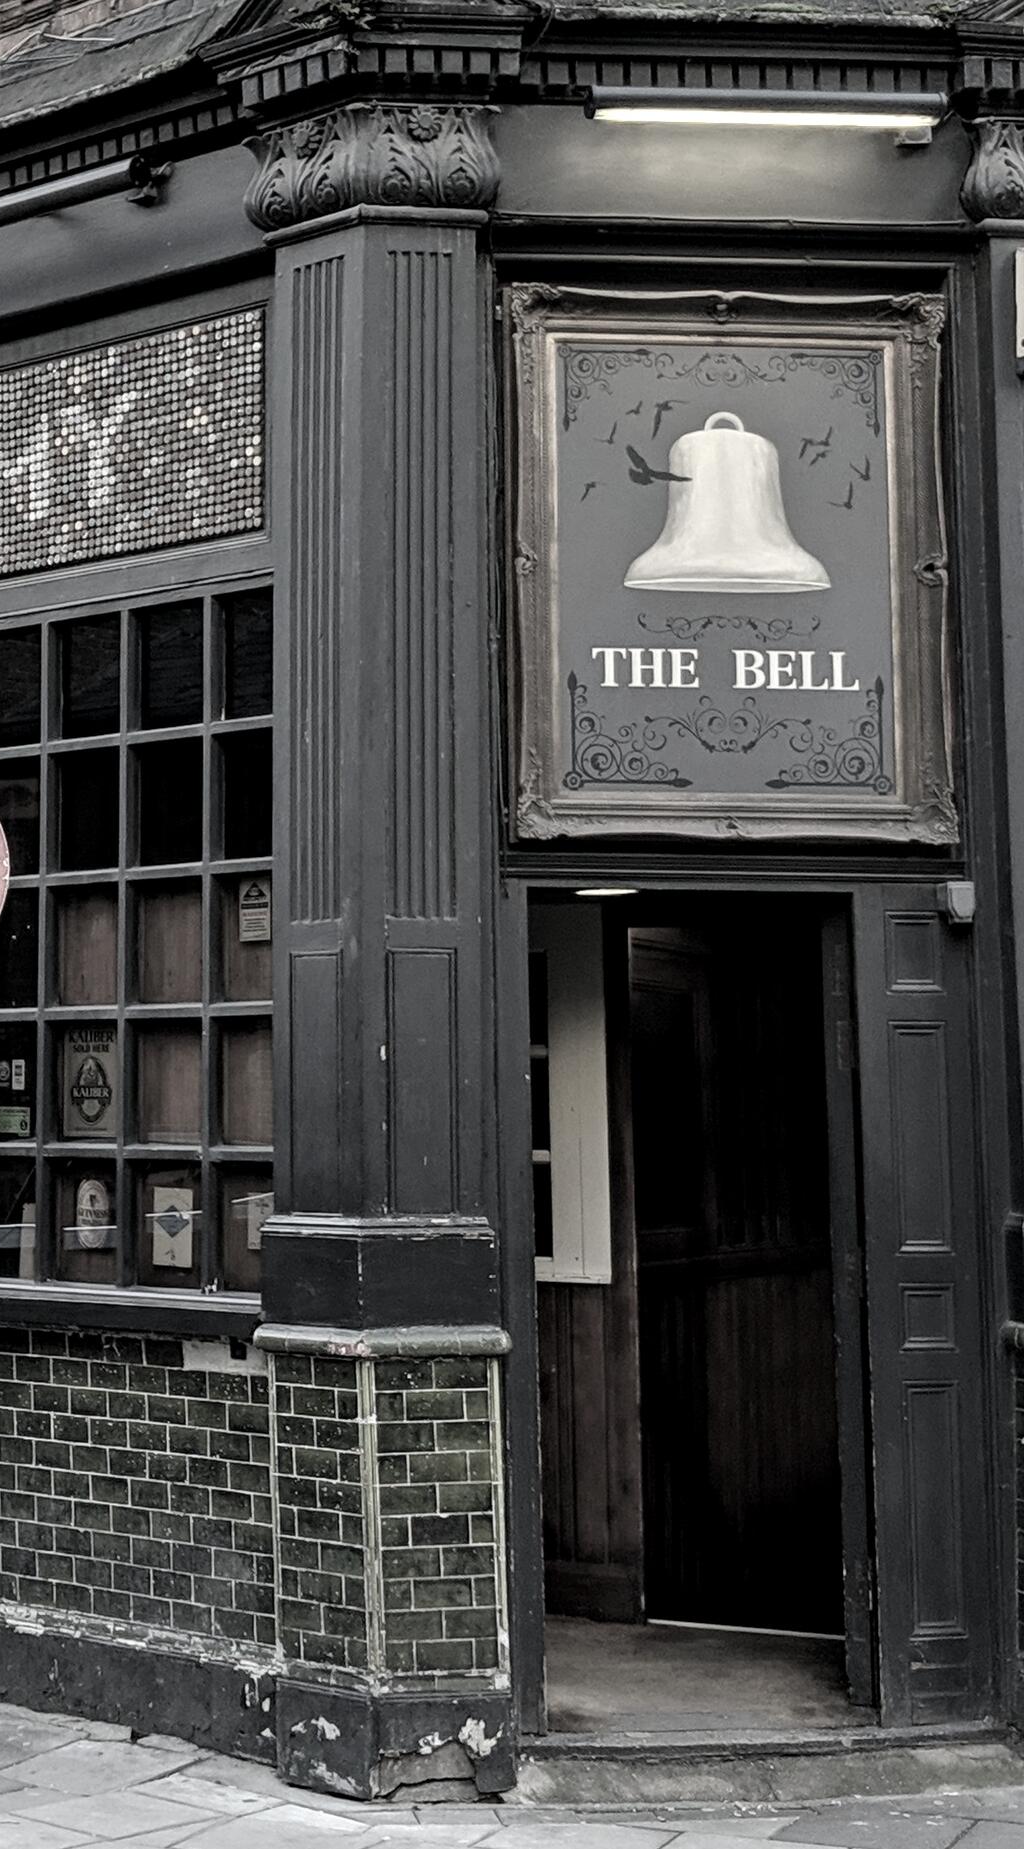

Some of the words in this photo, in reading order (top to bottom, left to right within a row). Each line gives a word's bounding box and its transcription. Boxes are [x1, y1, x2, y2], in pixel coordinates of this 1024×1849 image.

[592, 647, 699, 688] THE
[732, 649, 860, 691] BELL
[73, 1086, 110, 1098] KALIBER
